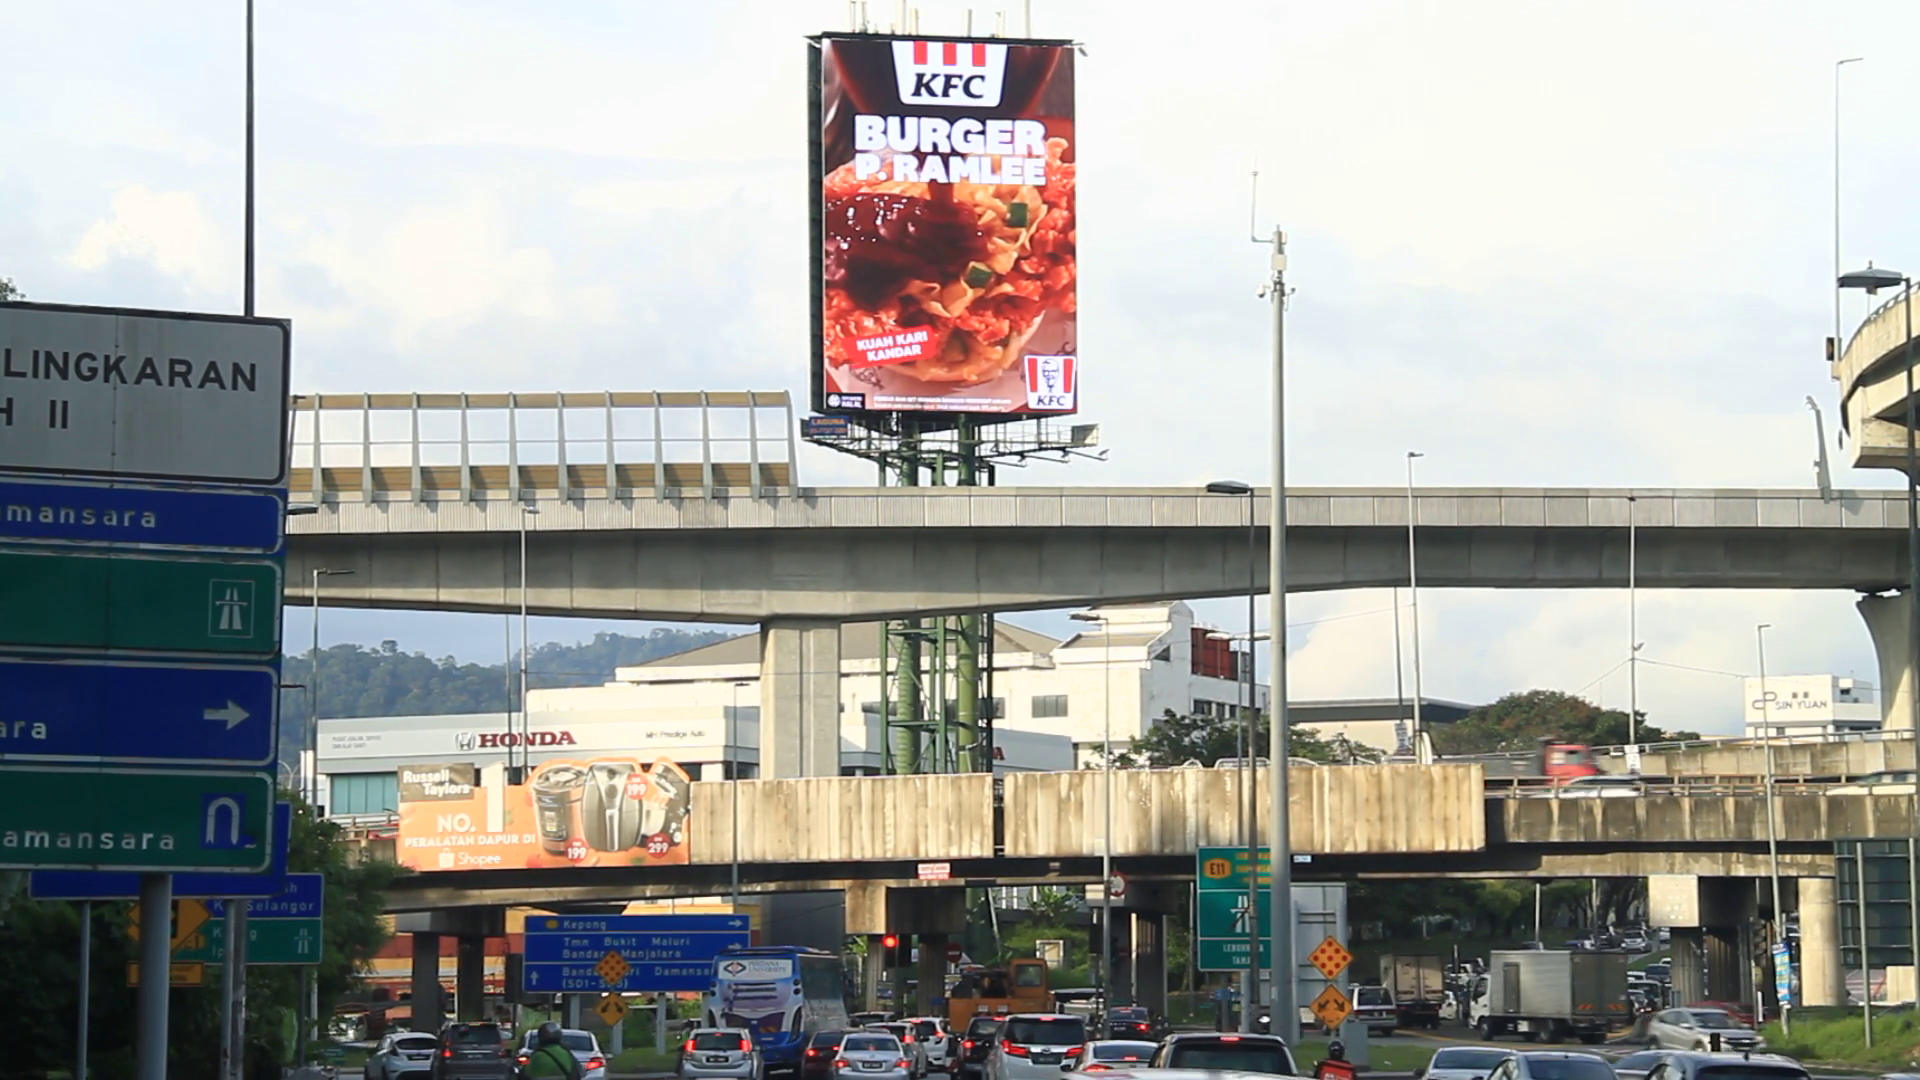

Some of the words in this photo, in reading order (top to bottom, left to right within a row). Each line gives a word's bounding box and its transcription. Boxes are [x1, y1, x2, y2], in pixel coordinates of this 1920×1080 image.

[911, 72, 986, 99] KFC
[854, 114, 1046, 156] BURGER
[855, 152, 888, 181] P.
[893, 154, 1047, 186] RAMLEE
[856, 335, 894, 351] KUAH
[895, 331, 929, 345] KARI
[866, 344, 923, 362] KANDAR
[3, 348, 257, 392] LINGKARAN
[1036, 396, 1067, 406] KFC
[48, 399, 69, 429] II
[6, 503, 156, 528] mansara
[1796, 700, 1828, 709] YUAN
[478, 731, 577, 748] HONDA
[403, 769, 450, 784] Russell
[423, 781, 471, 798] Taylors
[626, 783, 647, 796] 199
[437, 813, 477, 833] NO.
[480, 762, 505, 833] 1
[3, 830, 175, 850] amansara
[404, 836, 475, 848] PERALATAN
[478, 834, 519, 845] DAPUR
[523, 833, 537, 844] DI
[567, 846, 587, 859] 199
[648, 842, 669, 854] 299
[457, 852, 501, 866] Shopee
[1210, 862, 1226, 876] E11
[247, 900, 315, 914] Selangor
[563, 919, 607, 931] Kepong
[564, 937, 589, 947] Tmn
[604, 936, 636, 946] Bukit
[651, 937, 690, 946] Maluri
[562, 948, 605, 958] Bandar
